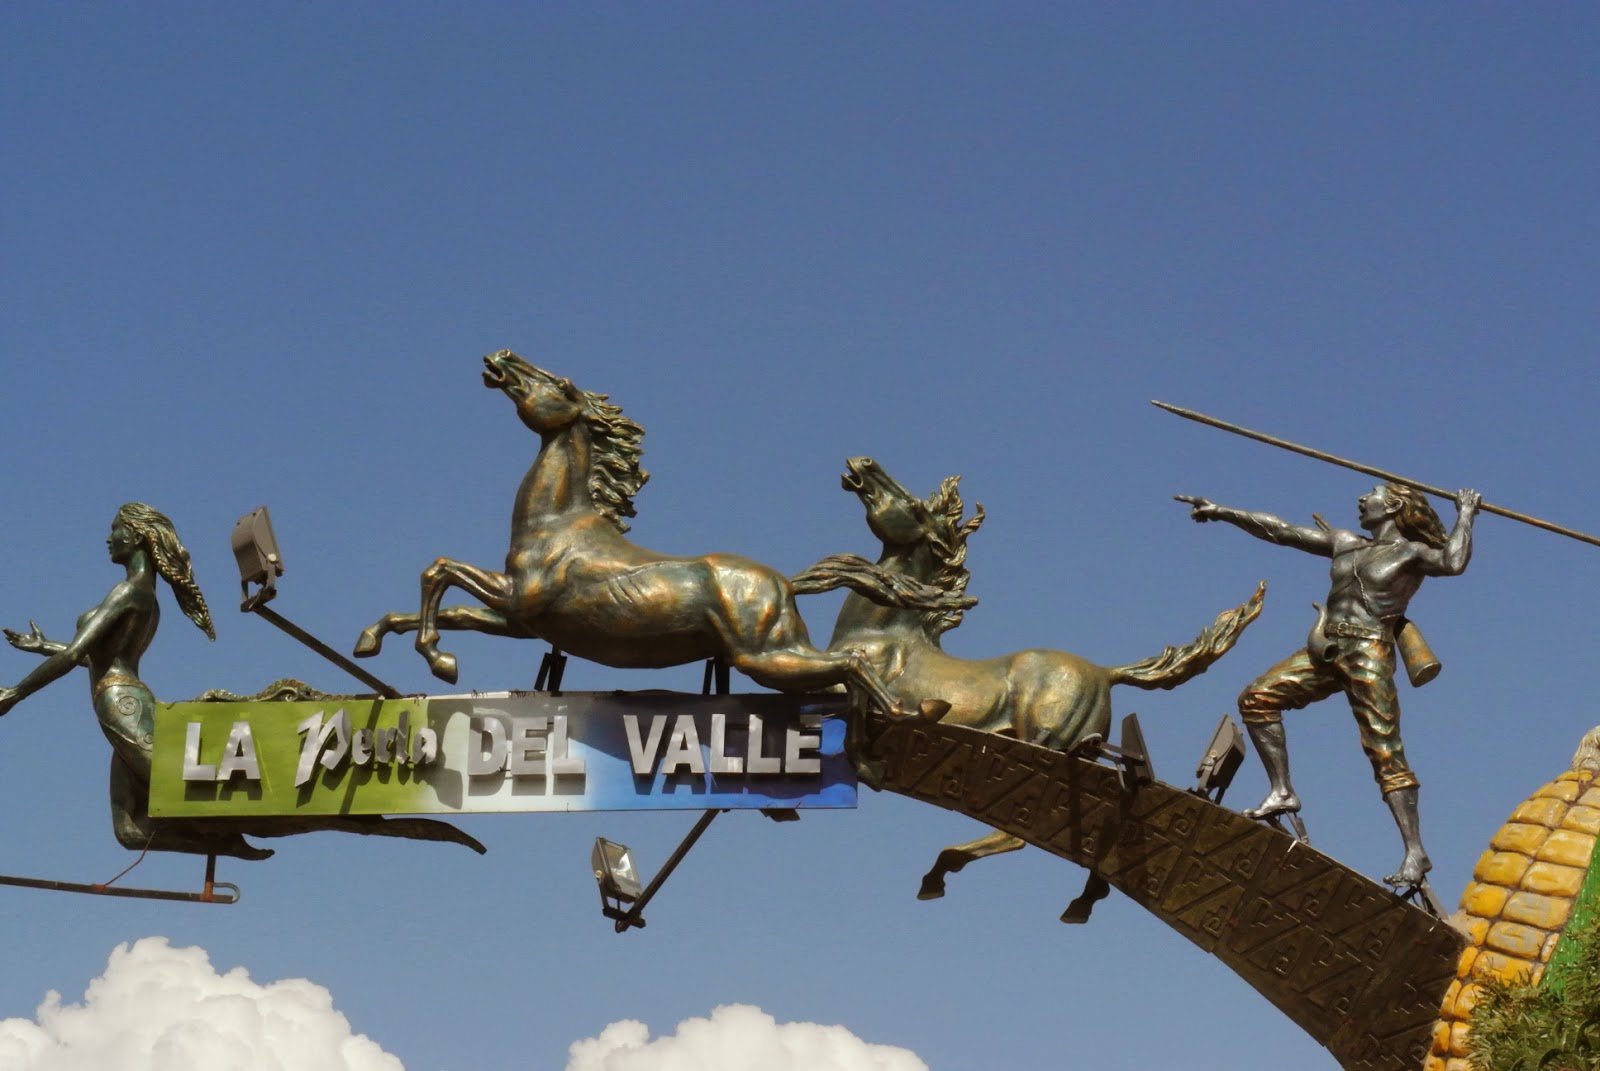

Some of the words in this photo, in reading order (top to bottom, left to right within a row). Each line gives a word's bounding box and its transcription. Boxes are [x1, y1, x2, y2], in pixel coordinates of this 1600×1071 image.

[182, 721, 262, 781] LA
[295, 708, 438, 788] Perla
[467, 714, 586, 776] DEL
[623, 713, 823, 775] VALLE
